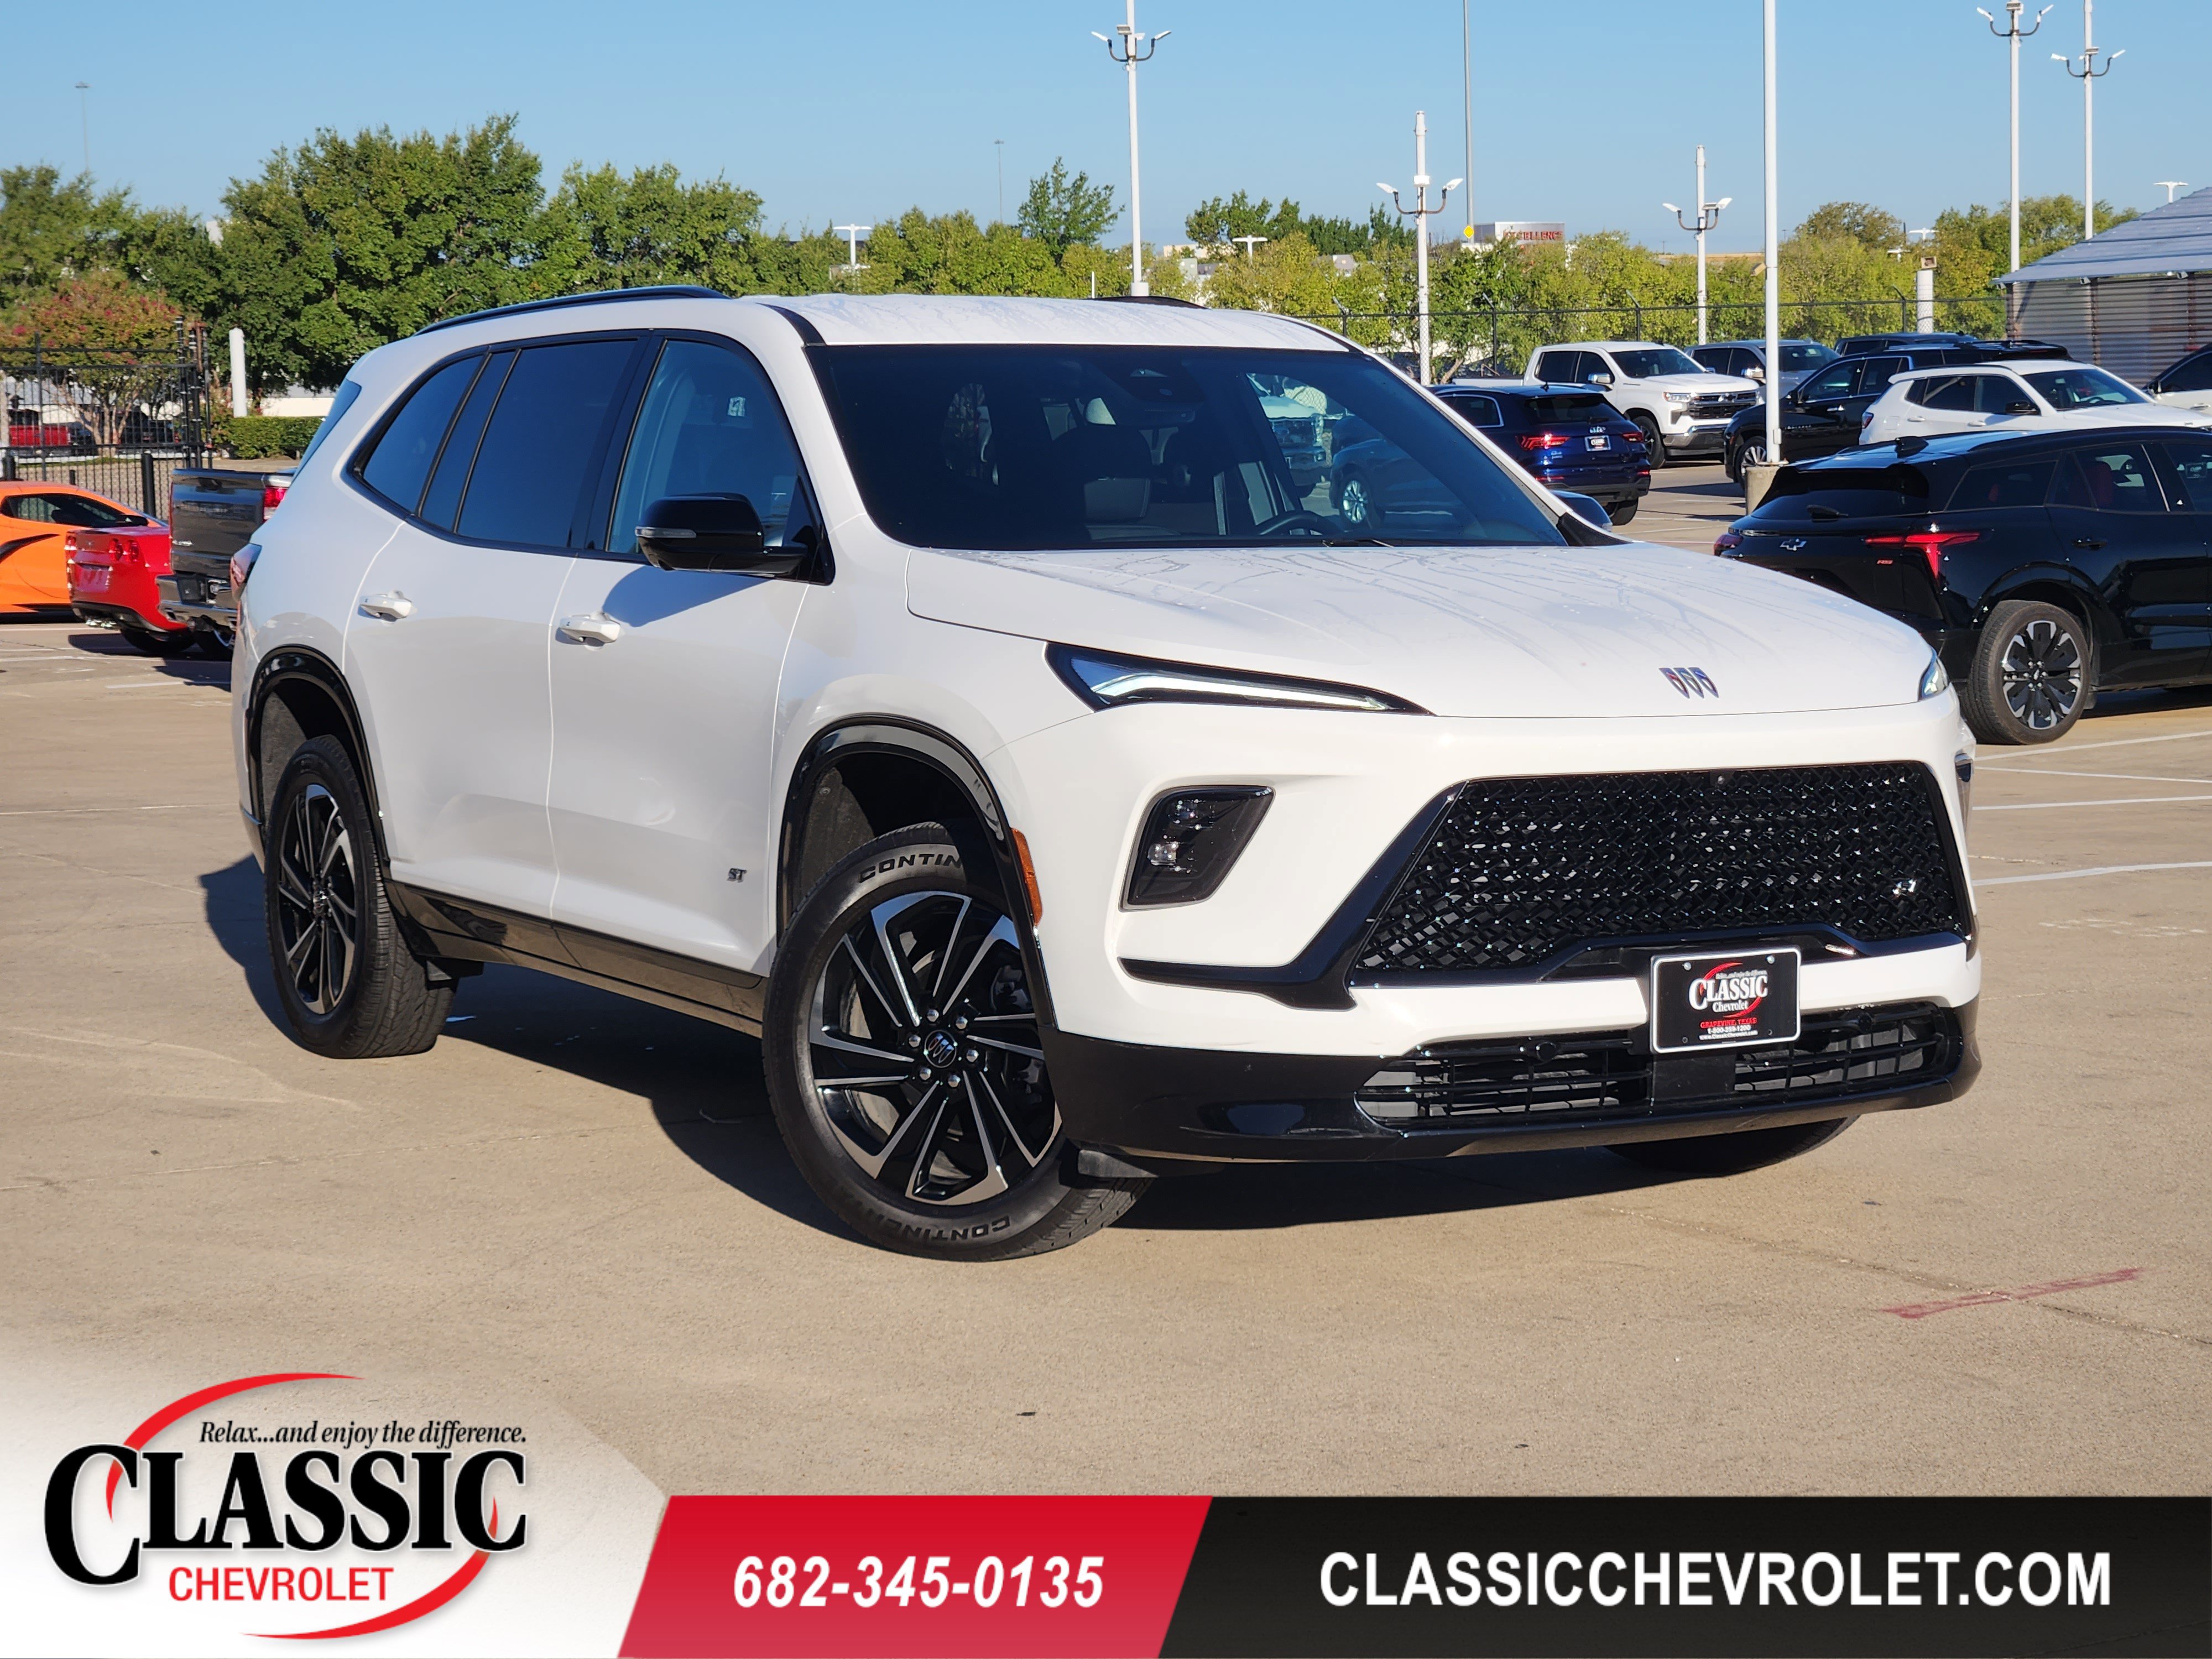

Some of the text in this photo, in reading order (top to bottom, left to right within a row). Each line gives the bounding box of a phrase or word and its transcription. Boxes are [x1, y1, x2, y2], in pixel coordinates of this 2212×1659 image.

[727, 868, 747, 883] ST
[859, 853, 962, 883] CONTIN
[1689, 975, 1768, 1010] CLASSIC
[1712, 1000, 1749, 1013] Chevrolet
